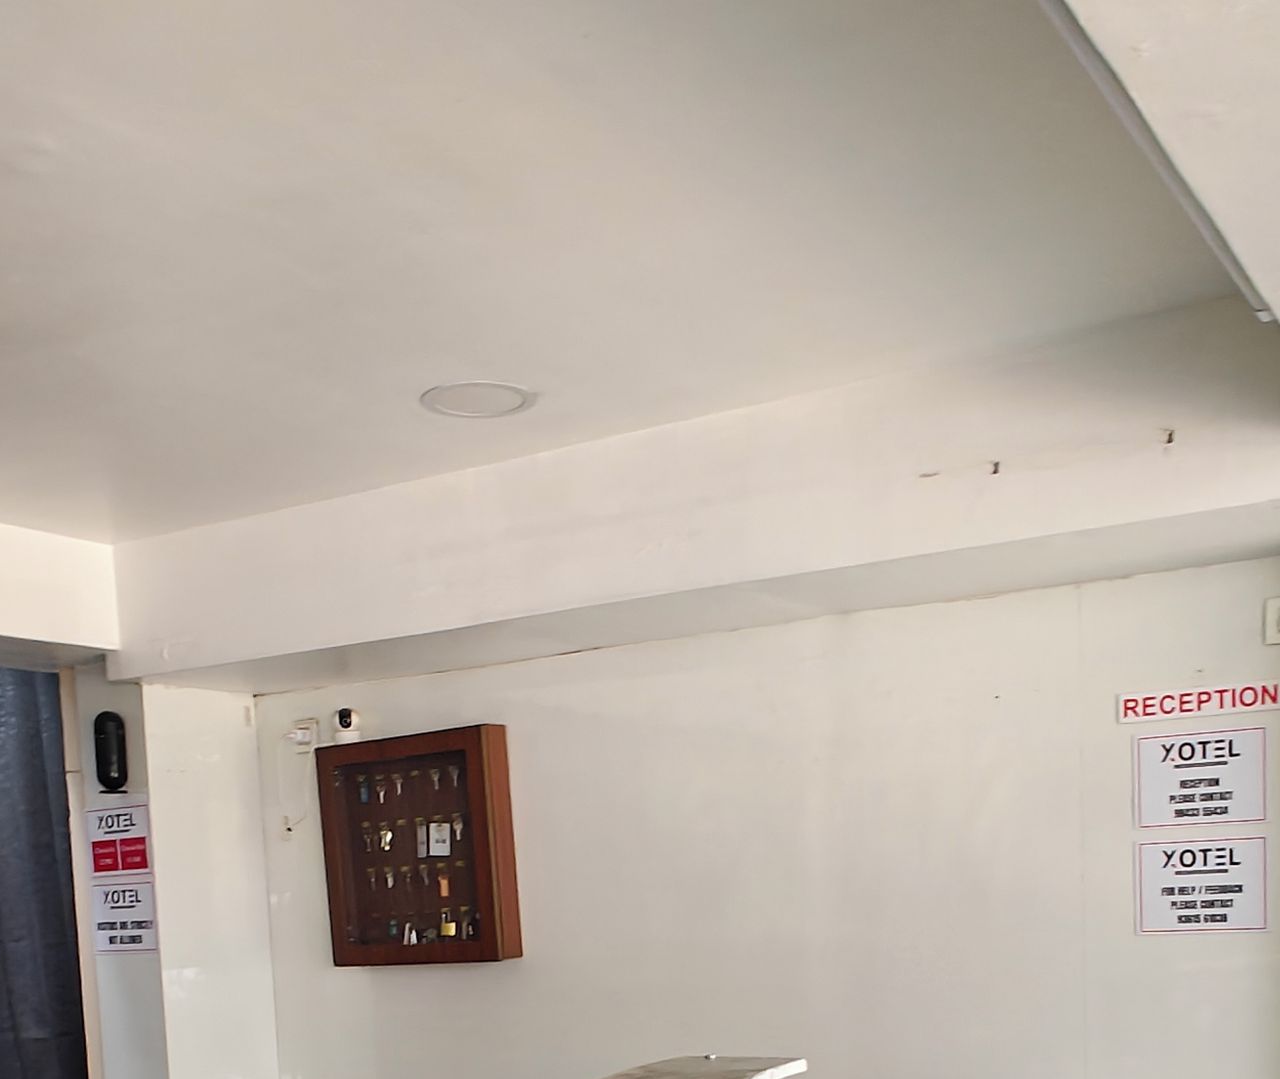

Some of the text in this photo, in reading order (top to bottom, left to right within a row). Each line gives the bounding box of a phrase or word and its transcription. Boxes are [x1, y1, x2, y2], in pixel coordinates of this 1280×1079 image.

[1122, 684, 1279, 719] RECEPTION
[1160, 739, 1242, 763] XOTEL
[1161, 847, 1242, 868] XOTEL
